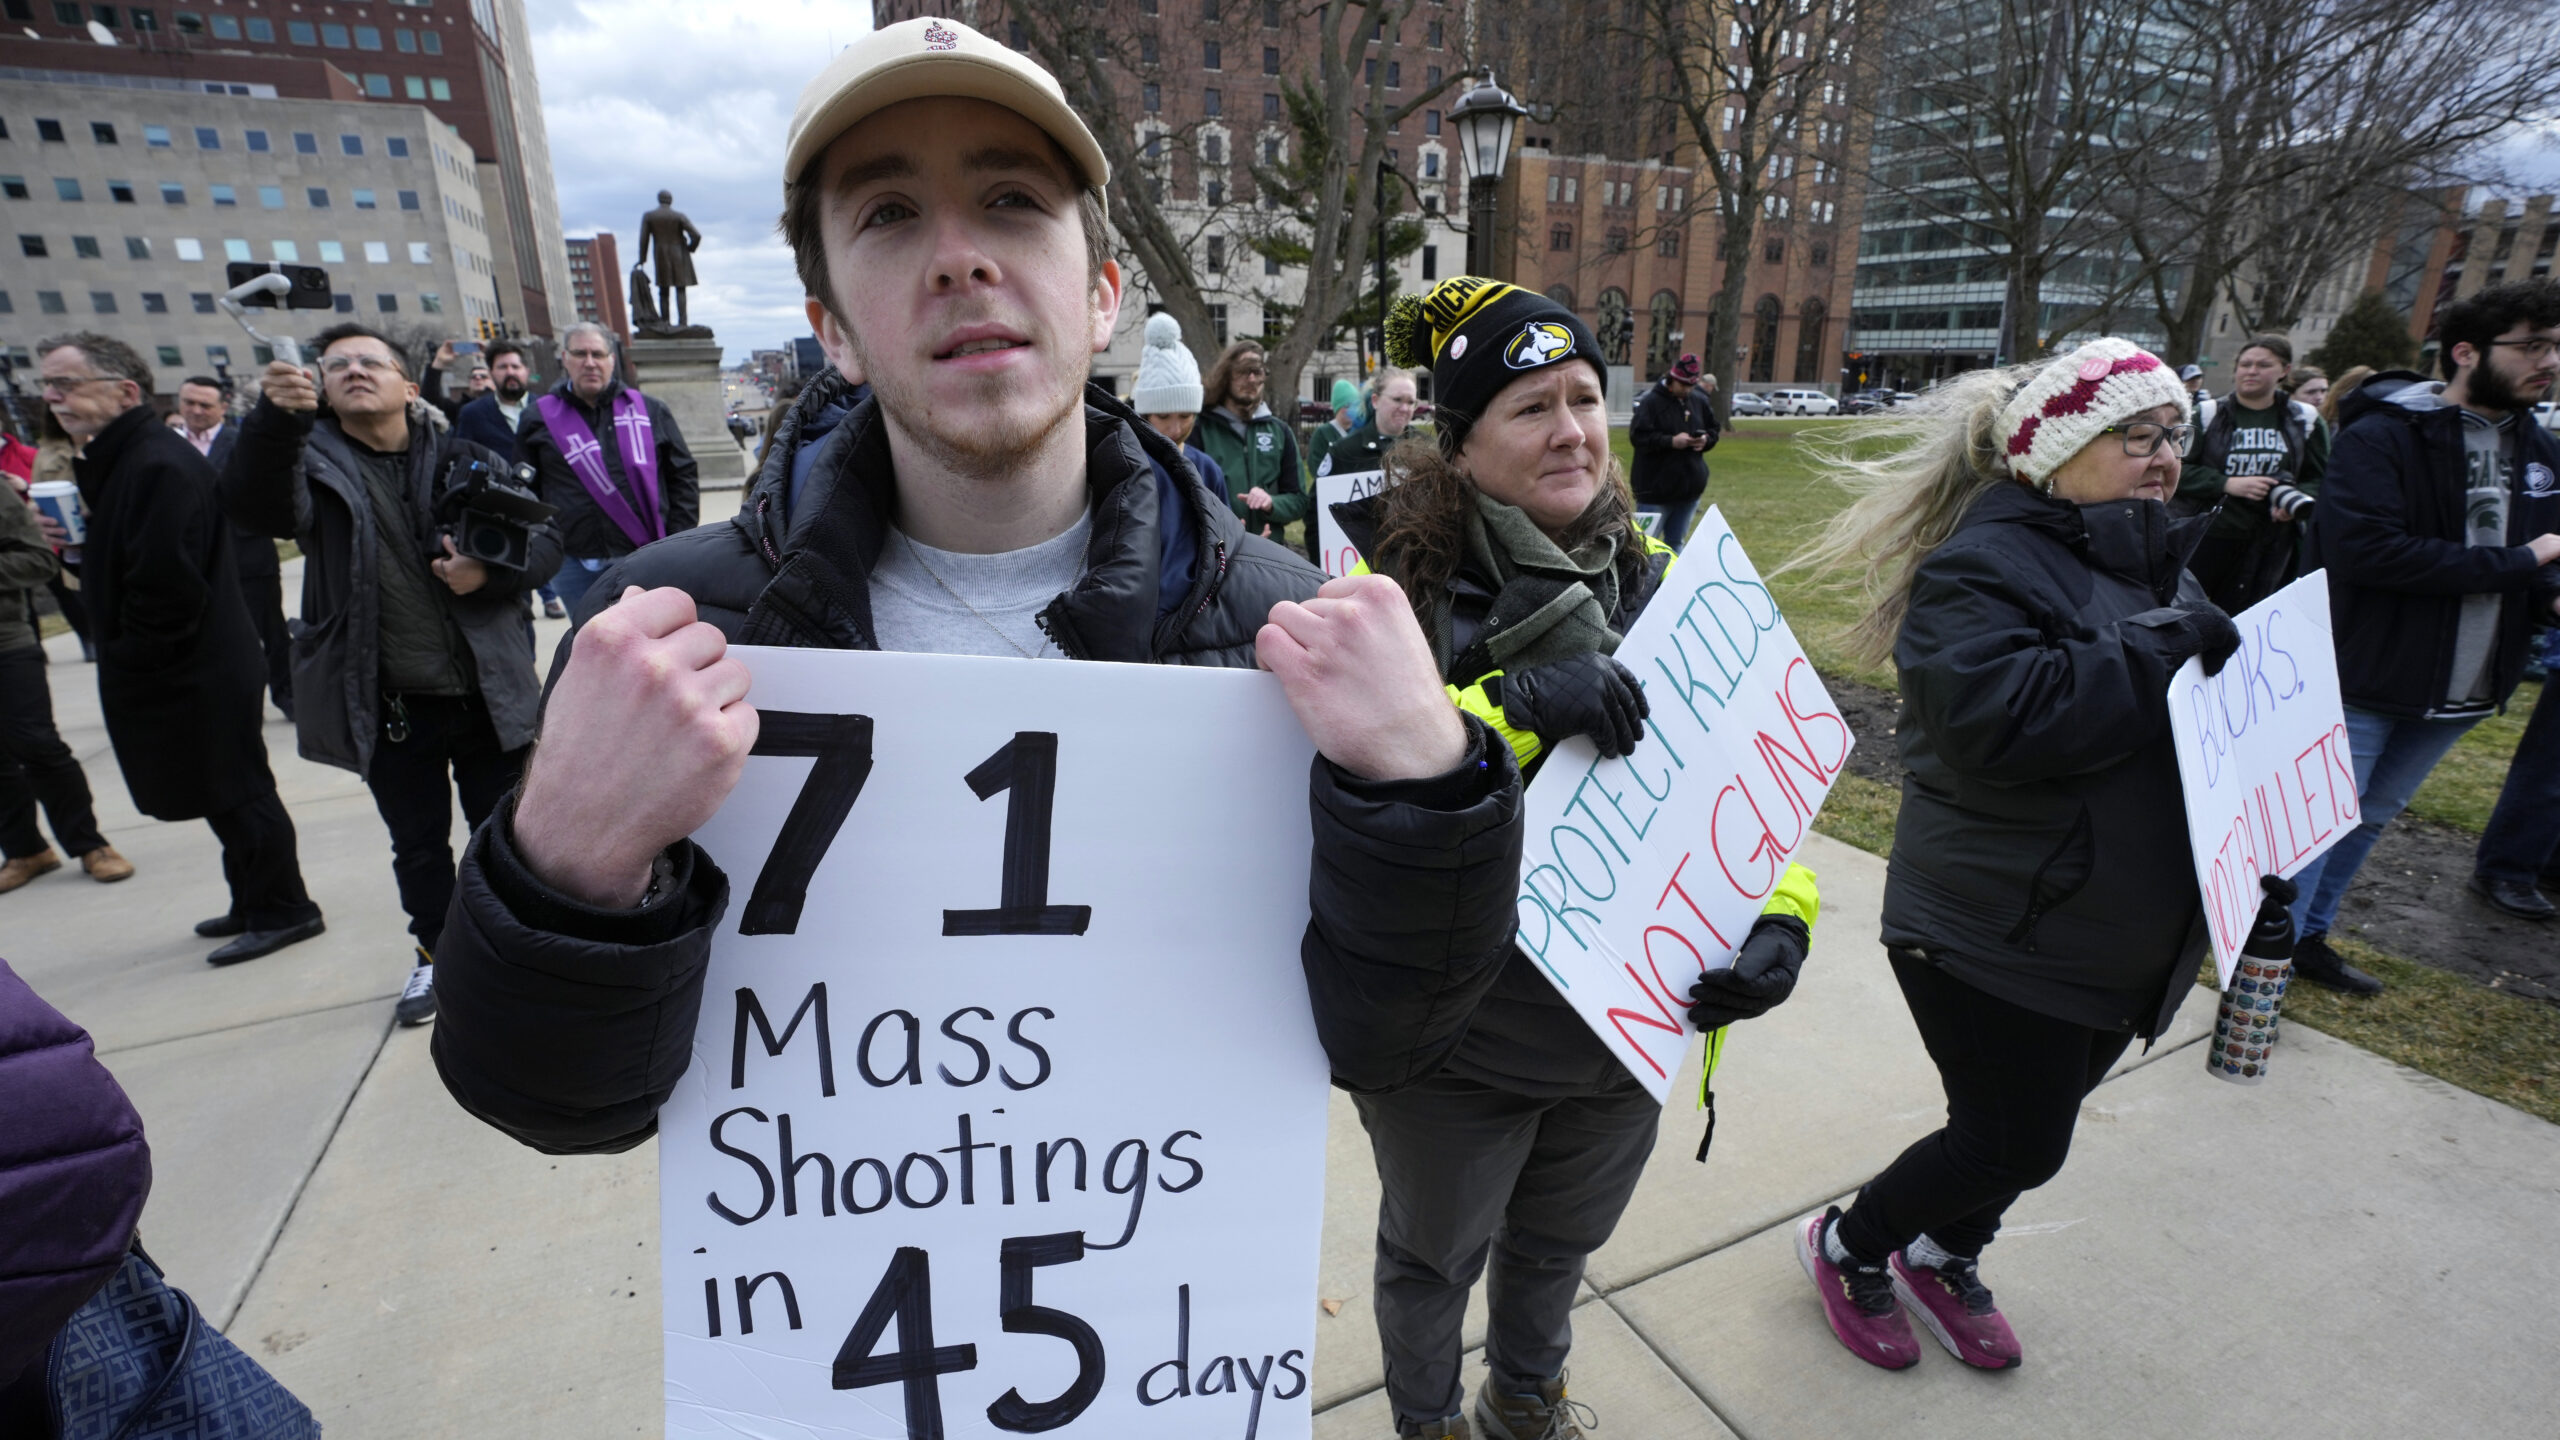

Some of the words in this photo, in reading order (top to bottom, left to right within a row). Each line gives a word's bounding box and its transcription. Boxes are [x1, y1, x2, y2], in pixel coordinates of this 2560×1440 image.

[2225, 453, 2283, 476] STATE
[738, 709, 1092, 936] 71
[1517, 680, 1685, 989] PROTECT
[1606, 852, 1732, 1080] NOT
[1711, 656, 1848, 901] GUNS
[2205, 830, 2245, 976] NOT
[2233, 723, 2359, 915] BULLETS
[731, 982, 1055, 1098] Mass
[706, 1106, 1204, 1249] Shootings
[694, 1246, 803, 1338] in
[831, 1230, 1107, 1440] 45
[1136, 1284, 1306, 1440] days
